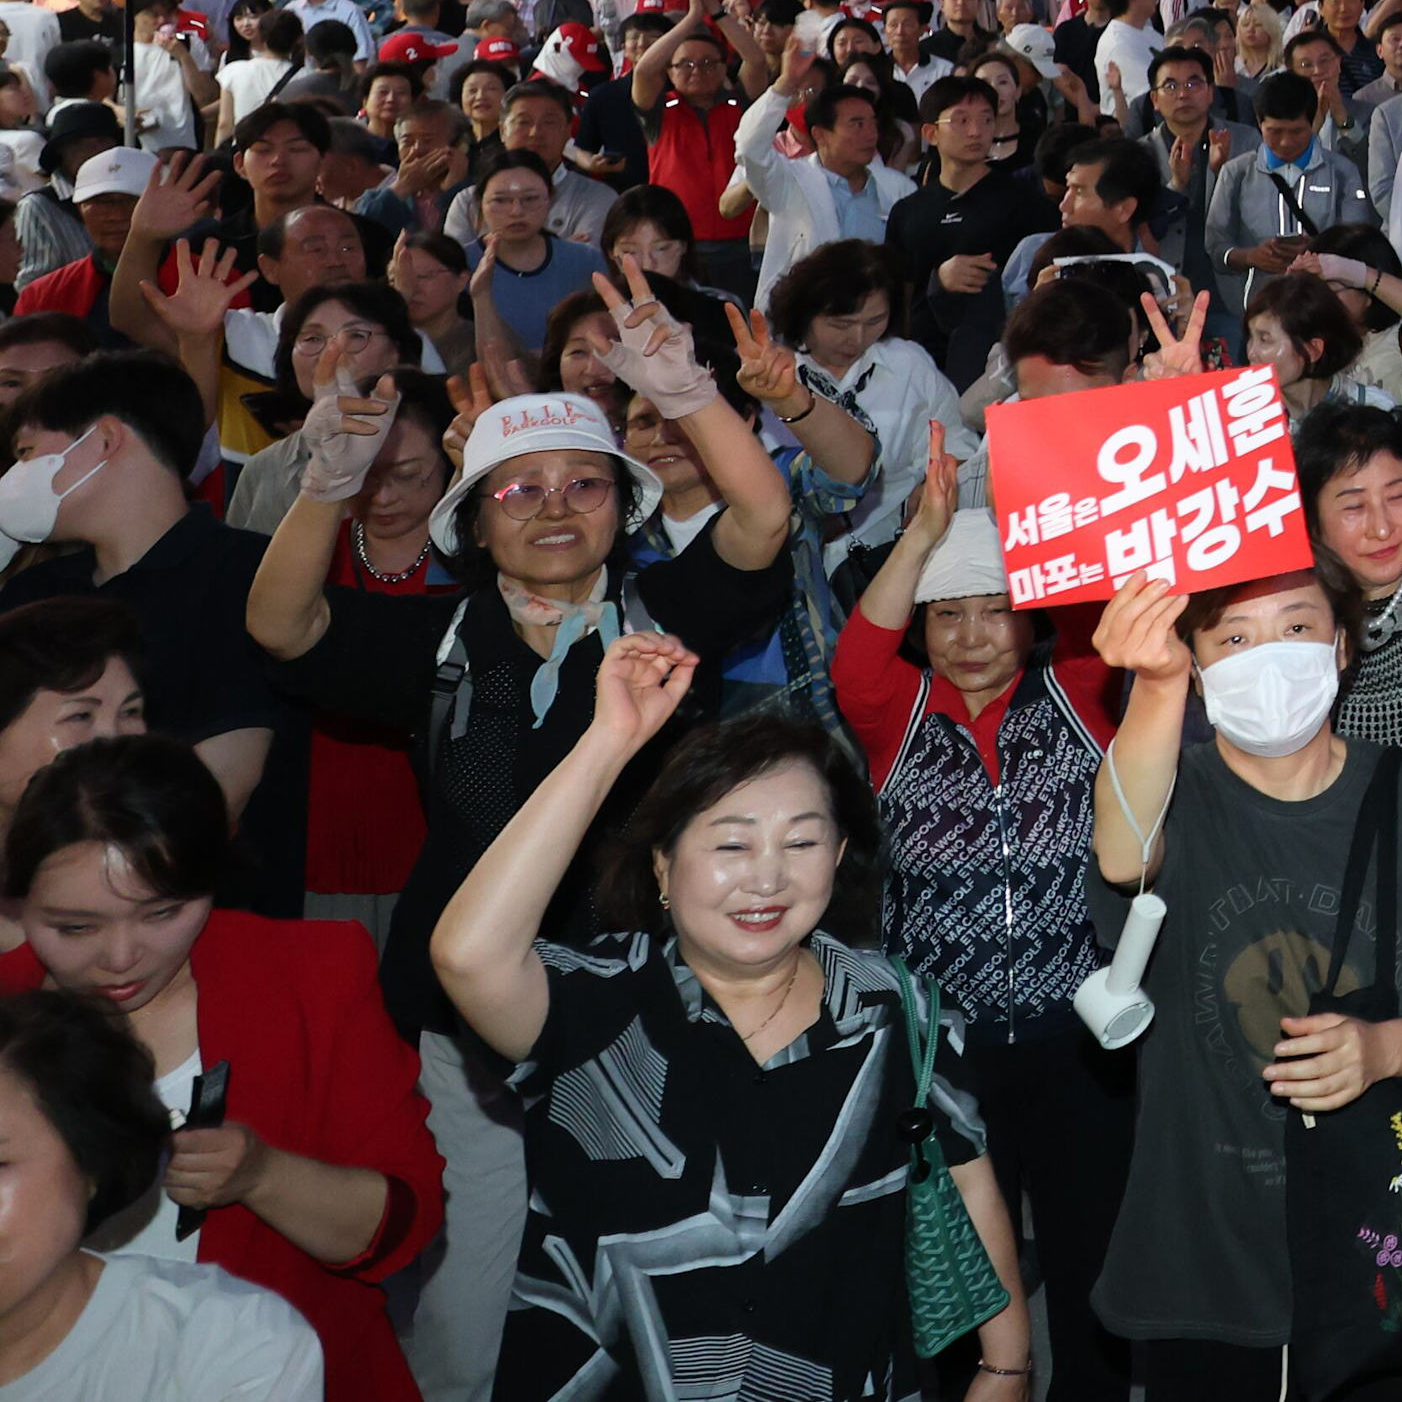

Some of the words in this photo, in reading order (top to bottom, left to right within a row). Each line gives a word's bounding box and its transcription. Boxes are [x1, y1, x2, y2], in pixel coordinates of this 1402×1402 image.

[407, 47, 418, 59] 2
[1005, 492, 1099, 552] 서울은
[1096, 366, 1285, 517] 오세훈
[1008, 553, 1105, 605] 마포는
[1105, 458, 1299, 591] 박강수
[910, 813, 976, 878] MACAWGOLF
[922, 838, 966, 882] ETERNO
[957, 837, 1001, 881] ETERNO
[1010, 798, 1057, 874] MACAWGOLF
[1019, 827, 1054, 876] ETERNO
[918, 878, 976, 943] MACAWGOLF
[929, 905, 967, 947] ETERNO
[958, 902, 1005, 946] ETERNO
[1012, 865, 1067, 942] MACAWGOLF
[1025, 895, 1064, 942] ETERNO
[1013, 931, 1075, 1007] MACAWGOLF
[1028, 960, 1072, 1007] ETERNO
